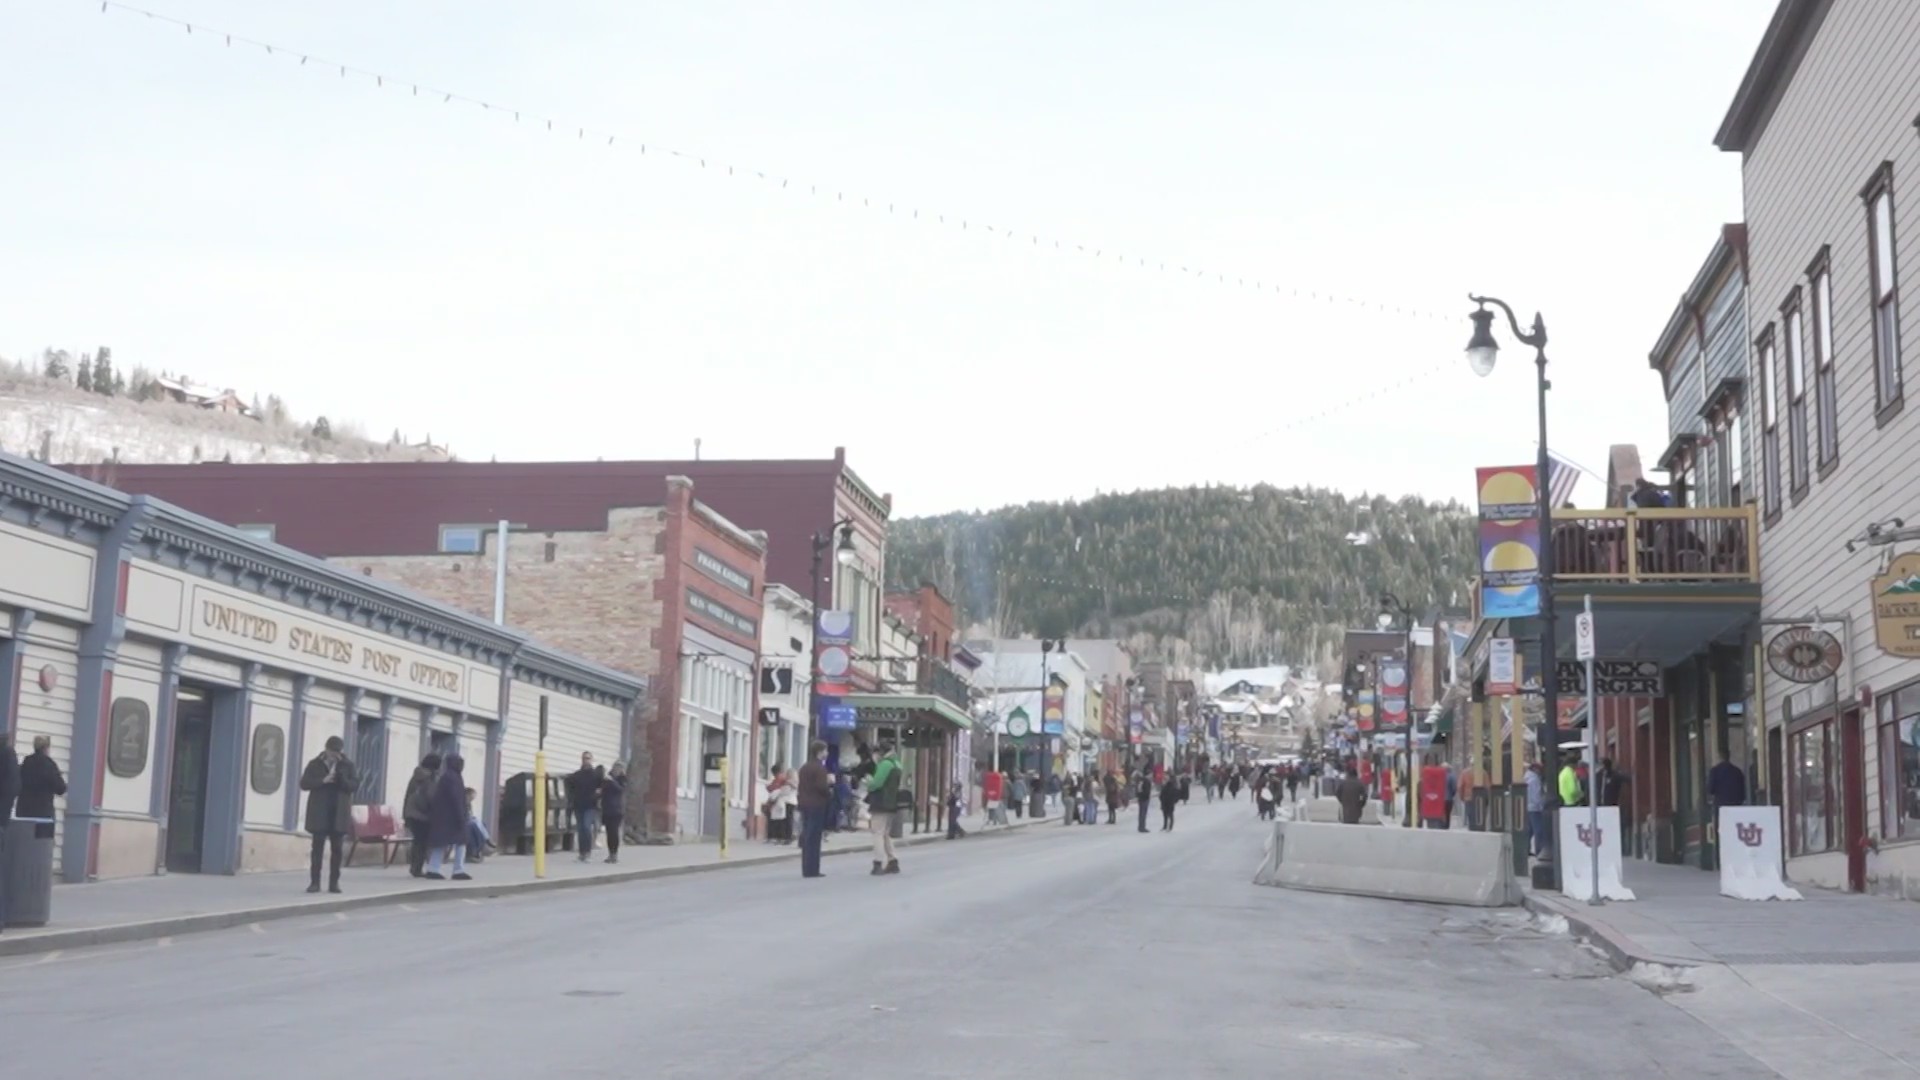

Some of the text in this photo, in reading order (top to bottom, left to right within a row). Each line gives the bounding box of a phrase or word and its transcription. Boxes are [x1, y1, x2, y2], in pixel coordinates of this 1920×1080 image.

[203, 600, 460, 693] UNITED STATES POST OFFICE
[1557, 678, 1660, 694] BURGER
